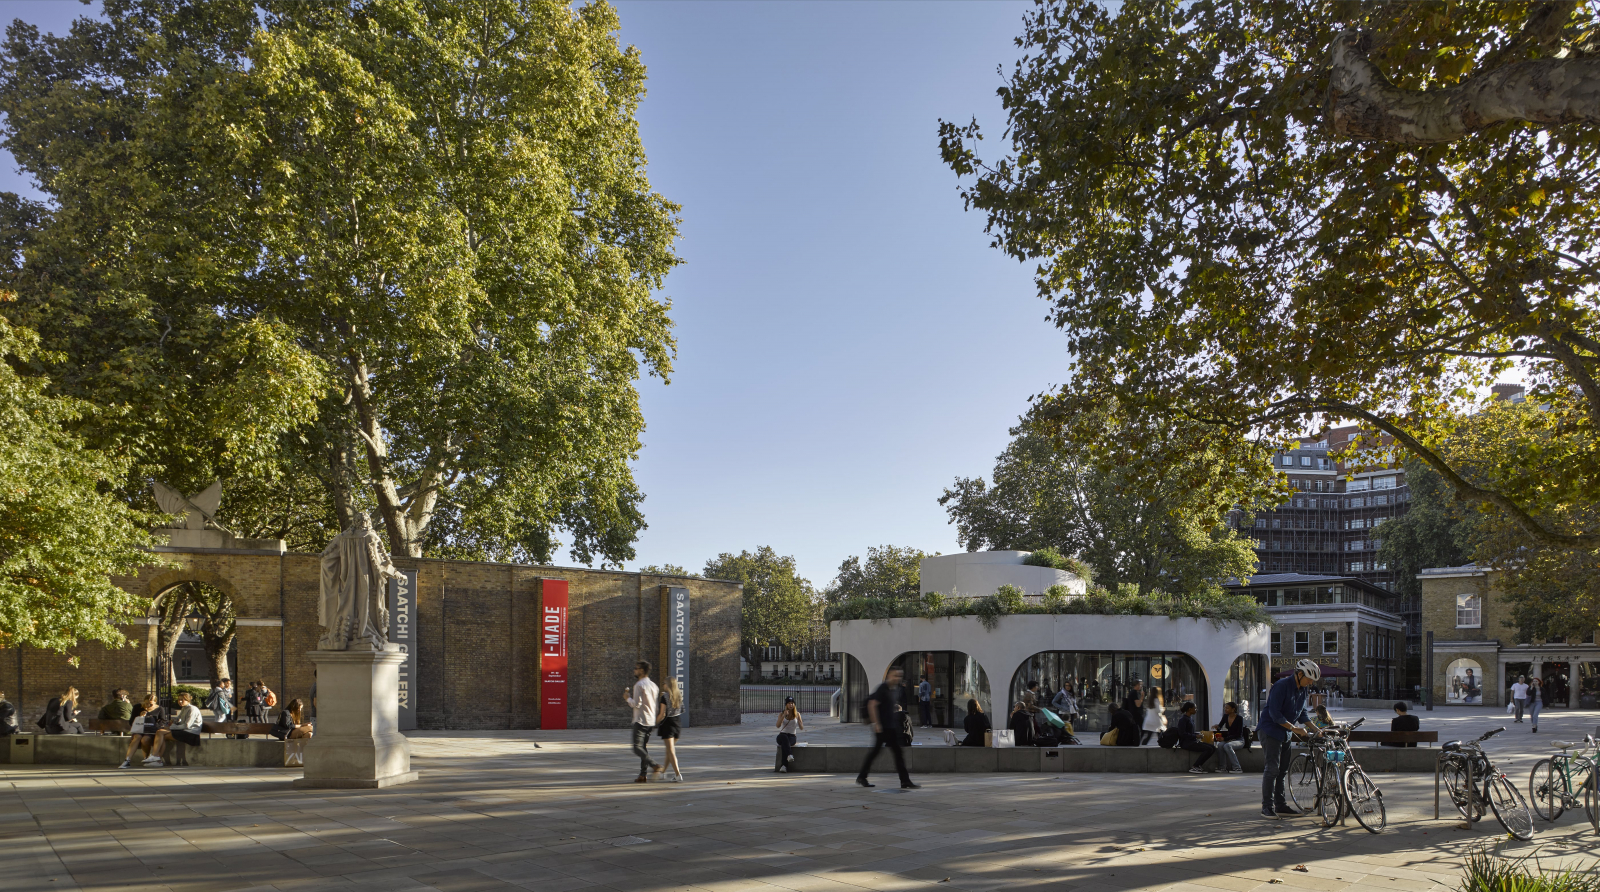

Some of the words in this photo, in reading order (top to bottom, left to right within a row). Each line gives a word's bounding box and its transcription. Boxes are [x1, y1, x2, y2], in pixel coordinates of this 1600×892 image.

[397, 576, 409, 639] SAATCHI
[545, 606, 559, 656] I-MADE
[676, 593, 685, 646] SAATCHI
[398, 643, 409, 709] GLLERY
[676, 649, 685, 705] GALLE
